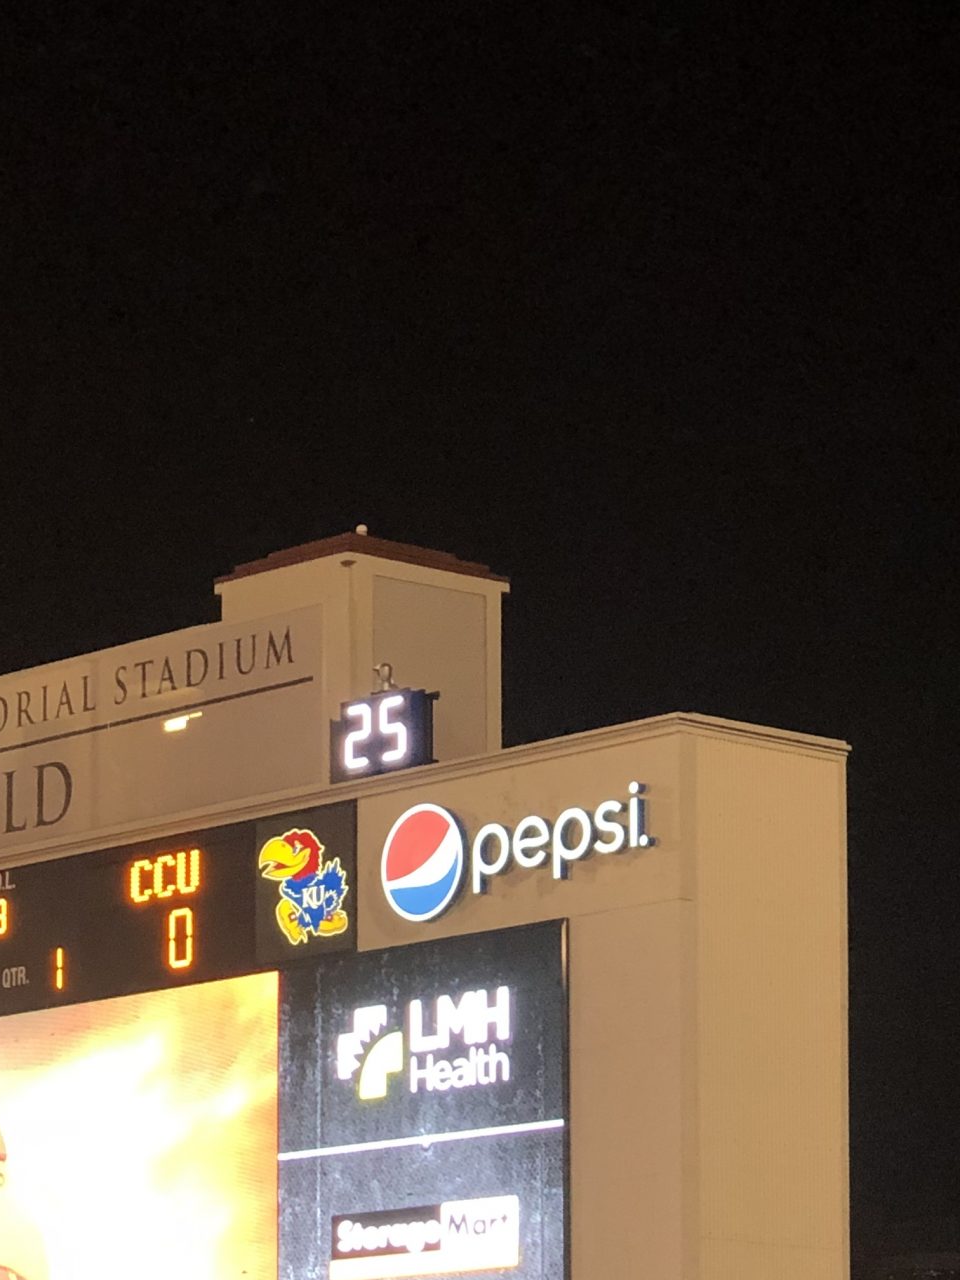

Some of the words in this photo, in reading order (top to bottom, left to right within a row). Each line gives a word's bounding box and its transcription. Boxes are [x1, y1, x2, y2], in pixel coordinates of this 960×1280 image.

[114, 626, 295, 705] STADIUM
[343, 694, 407, 769] 25
[130, 849, 200, 903] CCU
[302, 885, 325, 909] KU
[168, 907, 193, 969] 0
[2, 966, 29, 988] QTR.
[56, 947, 63, 990] 1
[409, 985, 510, 1053] LMH
[410, 1043, 510, 1093] Health
